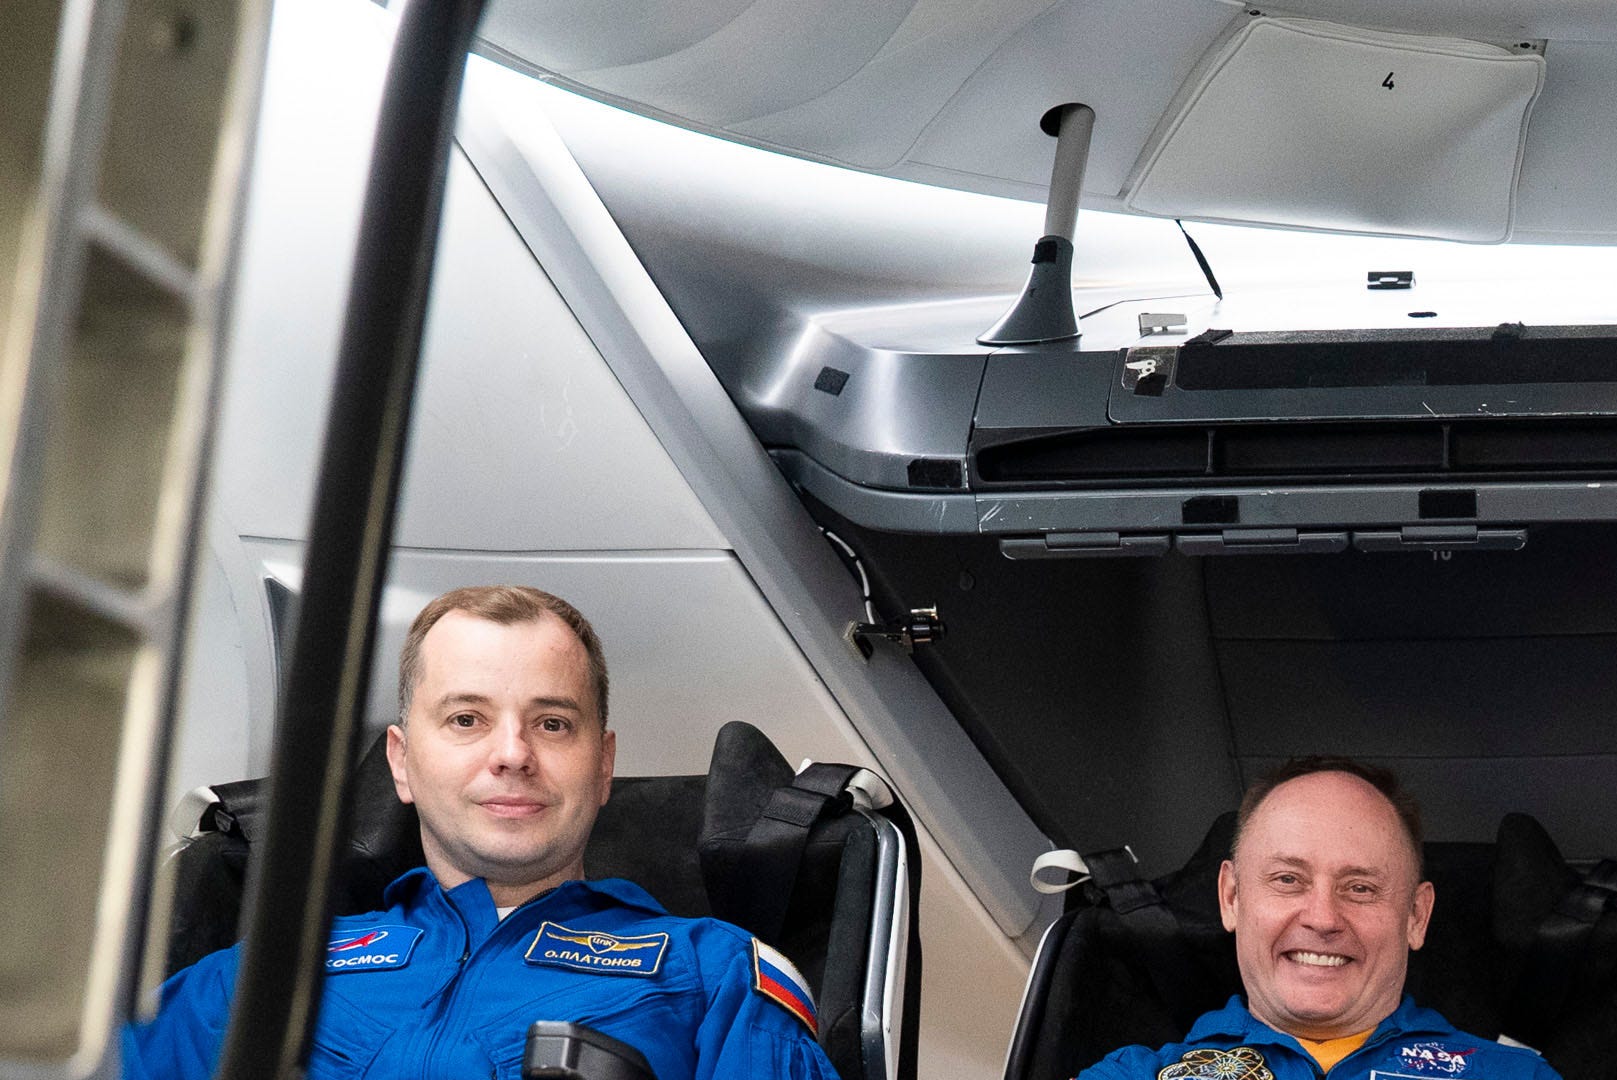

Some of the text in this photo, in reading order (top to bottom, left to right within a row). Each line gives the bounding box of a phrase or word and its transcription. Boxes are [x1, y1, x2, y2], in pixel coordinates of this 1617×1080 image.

[1382, 71, 1394, 90] 4
[325, 954, 399, 968] КОСМОС
[1402, 1047, 1466, 1066] NASA
